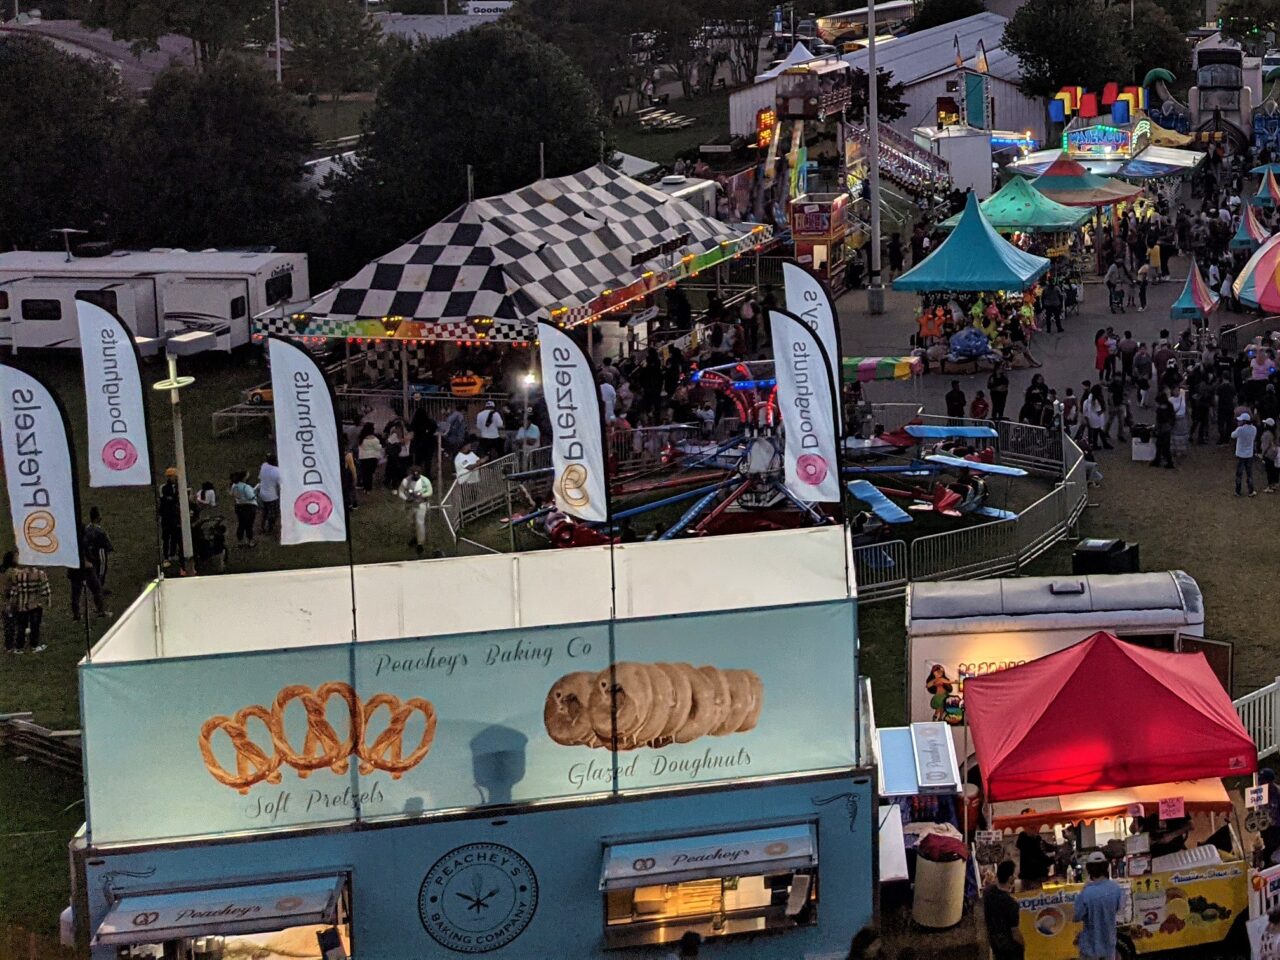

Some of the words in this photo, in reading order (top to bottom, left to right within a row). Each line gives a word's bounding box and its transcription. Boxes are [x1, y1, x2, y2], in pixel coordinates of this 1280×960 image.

[376, 646, 468, 676] Peachey's
[485, 639, 554, 666] Baking
[567, 637, 592, 658] Co
[568, 755, 639, 789] Glazed
[653, 747, 752, 777] Doughnuts
[245, 792, 289, 820] Soft
[306, 782, 384, 813] Pretzels
[435, 852, 521, 886] PEACHEY'S
[672, 847, 751, 866] Peachey's
[175, 904, 263, 922] Peachey's
[1017, 891, 1067, 911] ropical
[430, 912, 473, 944] BAKING
[475, 901, 528, 944] COMPANY
